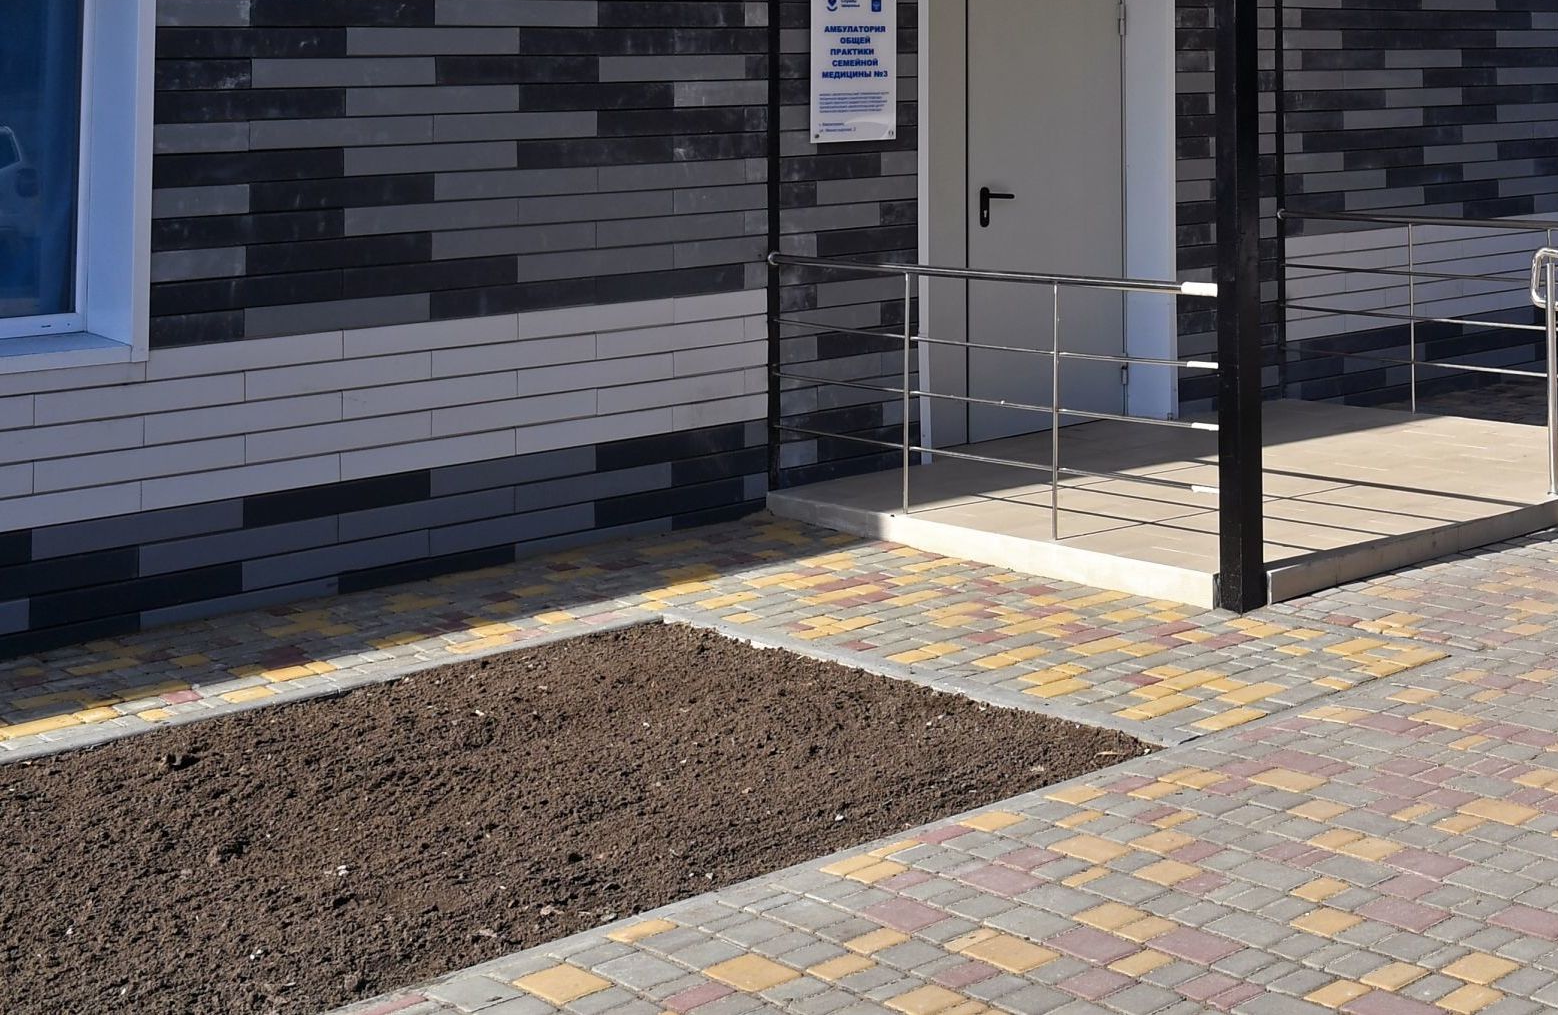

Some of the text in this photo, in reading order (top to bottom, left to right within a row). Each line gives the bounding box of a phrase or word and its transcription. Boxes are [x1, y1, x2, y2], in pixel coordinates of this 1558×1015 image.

[824, 25, 886, 33] АМБУЛАТОРИЯ
[840, 35, 871, 45] ОБЩЕЙ
[830, 48, 875, 56] ПРАКТИКИ
[832, 58, 879, 67] СЕМЕЙНОЙ
[822, 70, 889, 80] МЕДИЦИНЫ №3
